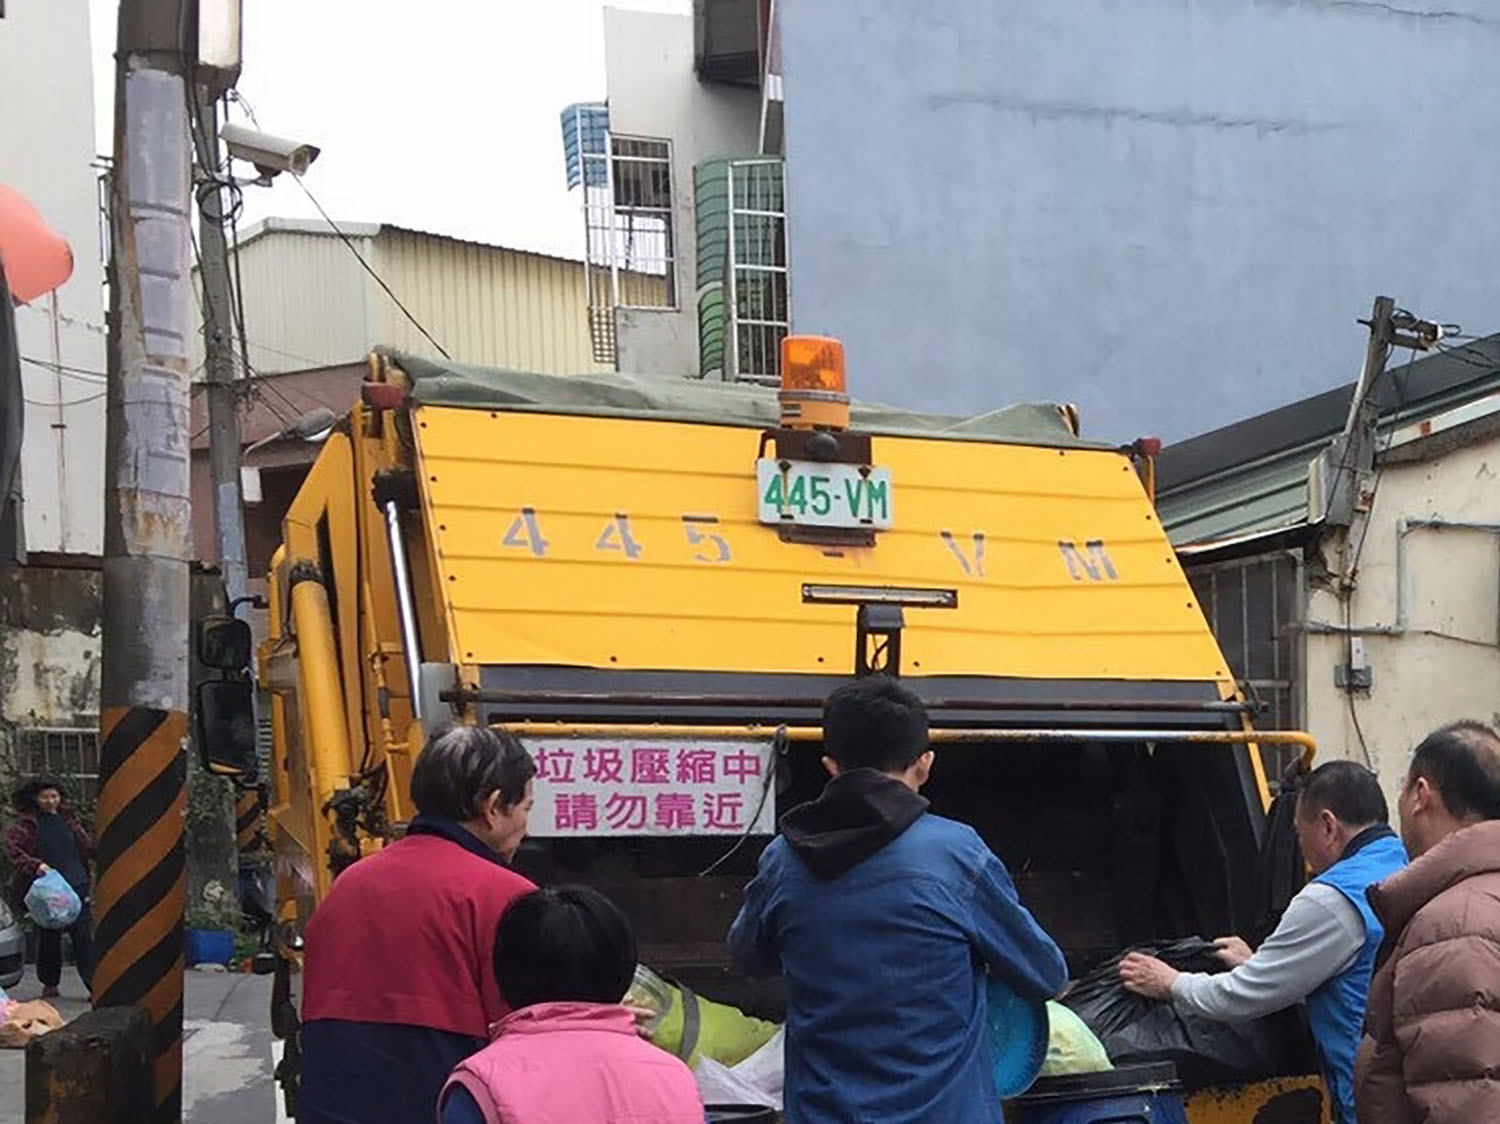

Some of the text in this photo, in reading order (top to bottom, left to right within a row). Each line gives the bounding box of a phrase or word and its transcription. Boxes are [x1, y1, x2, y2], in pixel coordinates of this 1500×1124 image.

[764, 473, 887, 519] 445-VM
[535, 747, 761, 784] 垃圾壓縮中
[554, 792, 745, 830] 請勿靠近
